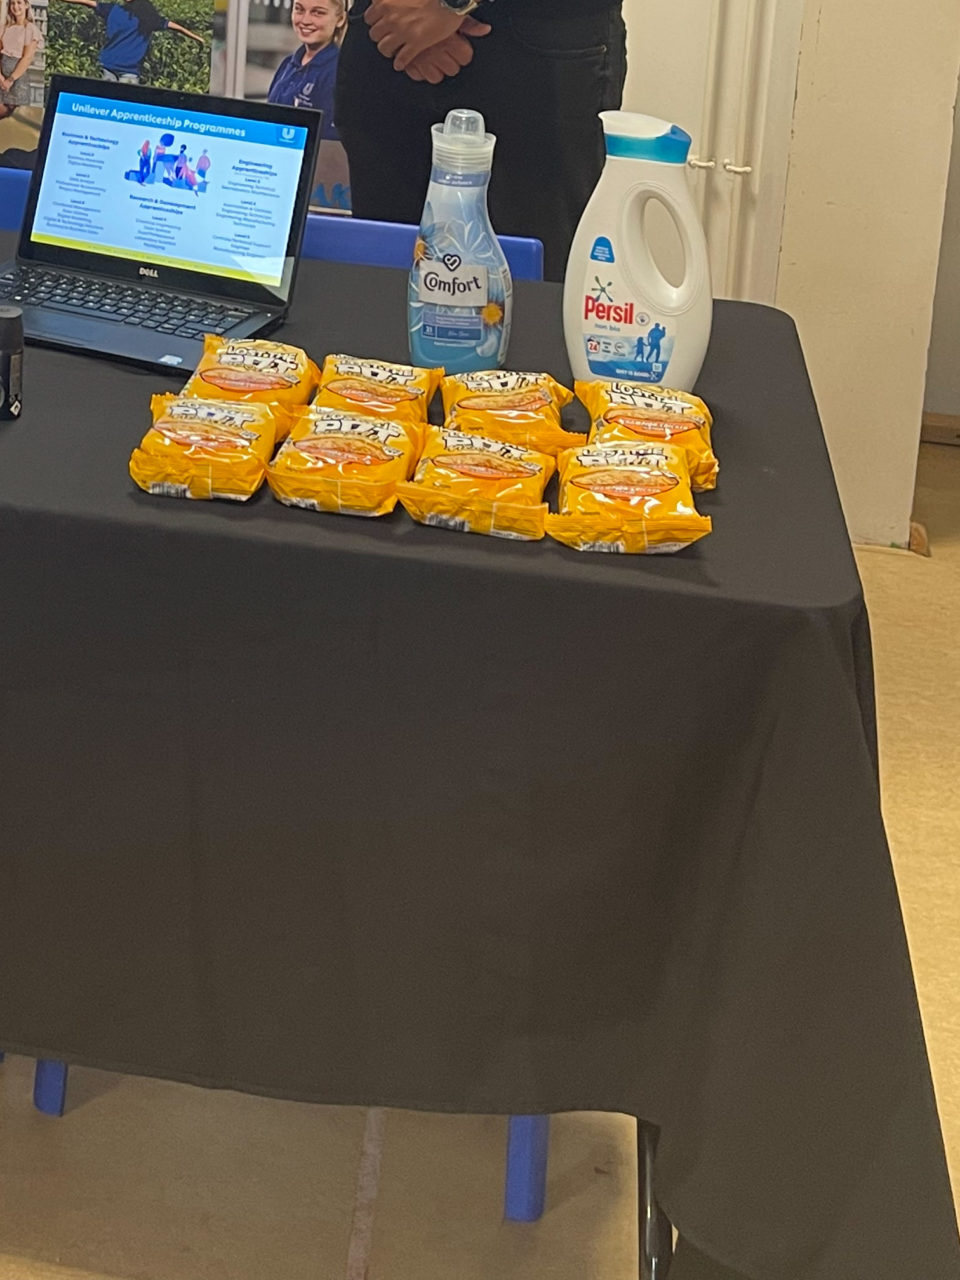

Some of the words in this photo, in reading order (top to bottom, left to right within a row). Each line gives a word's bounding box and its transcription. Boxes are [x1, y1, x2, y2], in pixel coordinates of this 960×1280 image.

[71, 102, 110, 116] Unilever
[110, 108, 182, 129] Apprenticeship
[183, 118, 246, 137] Programmes
[139, 266, 159, 278] DELL
[424, 271, 482, 296] Comfort
[584, 294, 635, 325] Persil
